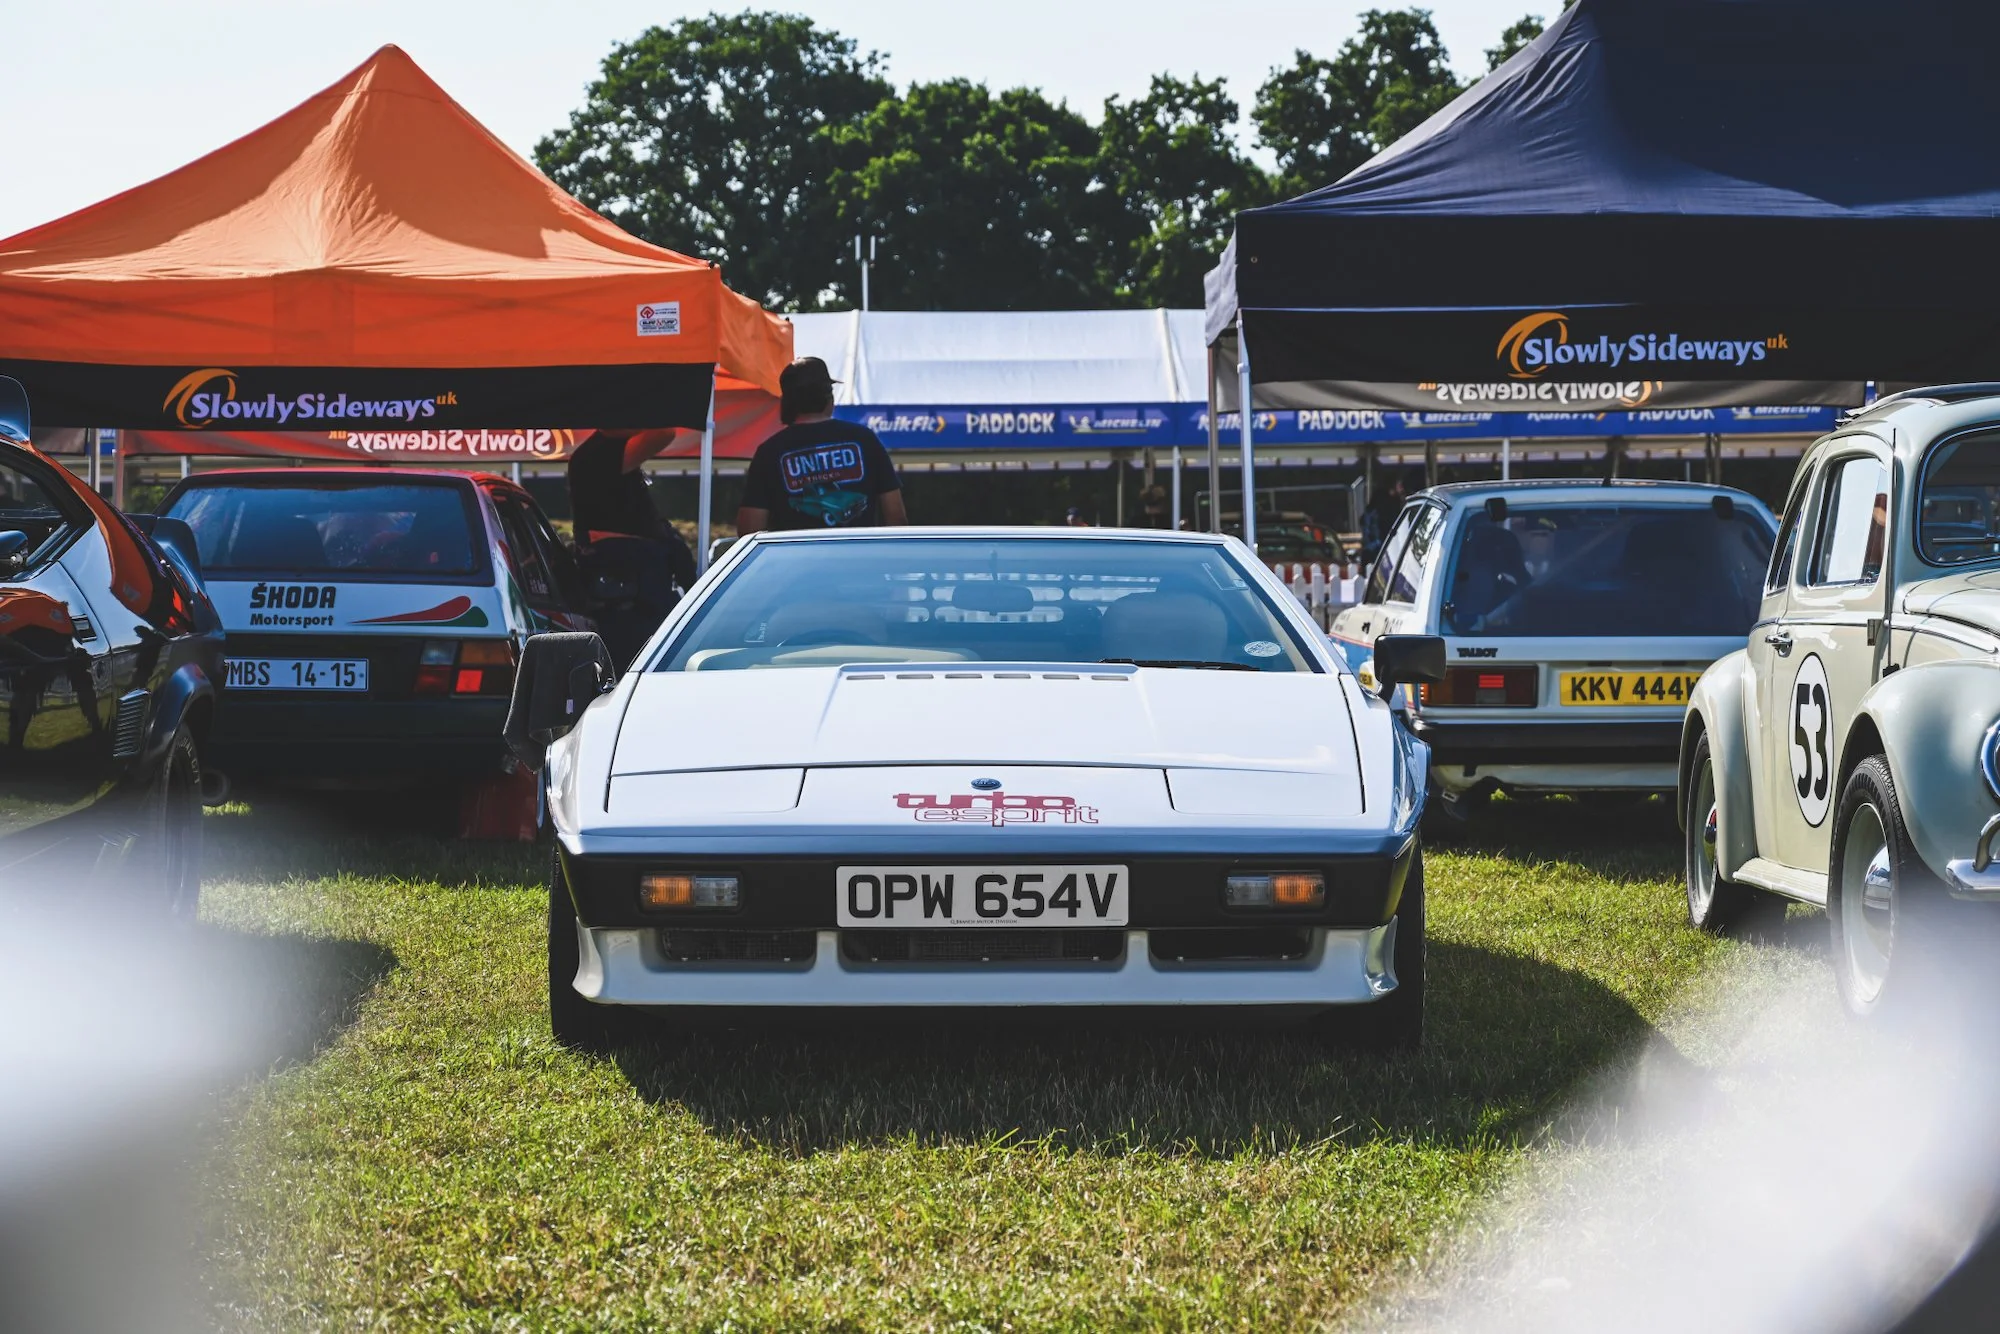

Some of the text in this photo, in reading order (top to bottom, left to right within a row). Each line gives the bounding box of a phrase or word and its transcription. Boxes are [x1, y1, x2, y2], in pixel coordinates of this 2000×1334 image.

[966, 413, 1054, 434] PADDOCK
[1298, 410, 1385, 430] PADDOCK
[786, 448, 856, 477] UNITED
[250, 582, 337, 609] ŠKODA
[250, 613, 334, 629] Motorsport
[229, 661, 356, 687] MBS 14-15
[1571, 676, 1622, 701] KKV
[1795, 683, 1829, 800] 53
[893, 792, 1076, 812] turbo
[915, 806, 1099, 828] esprit
[848, 873, 1118, 918] OPW 654V
